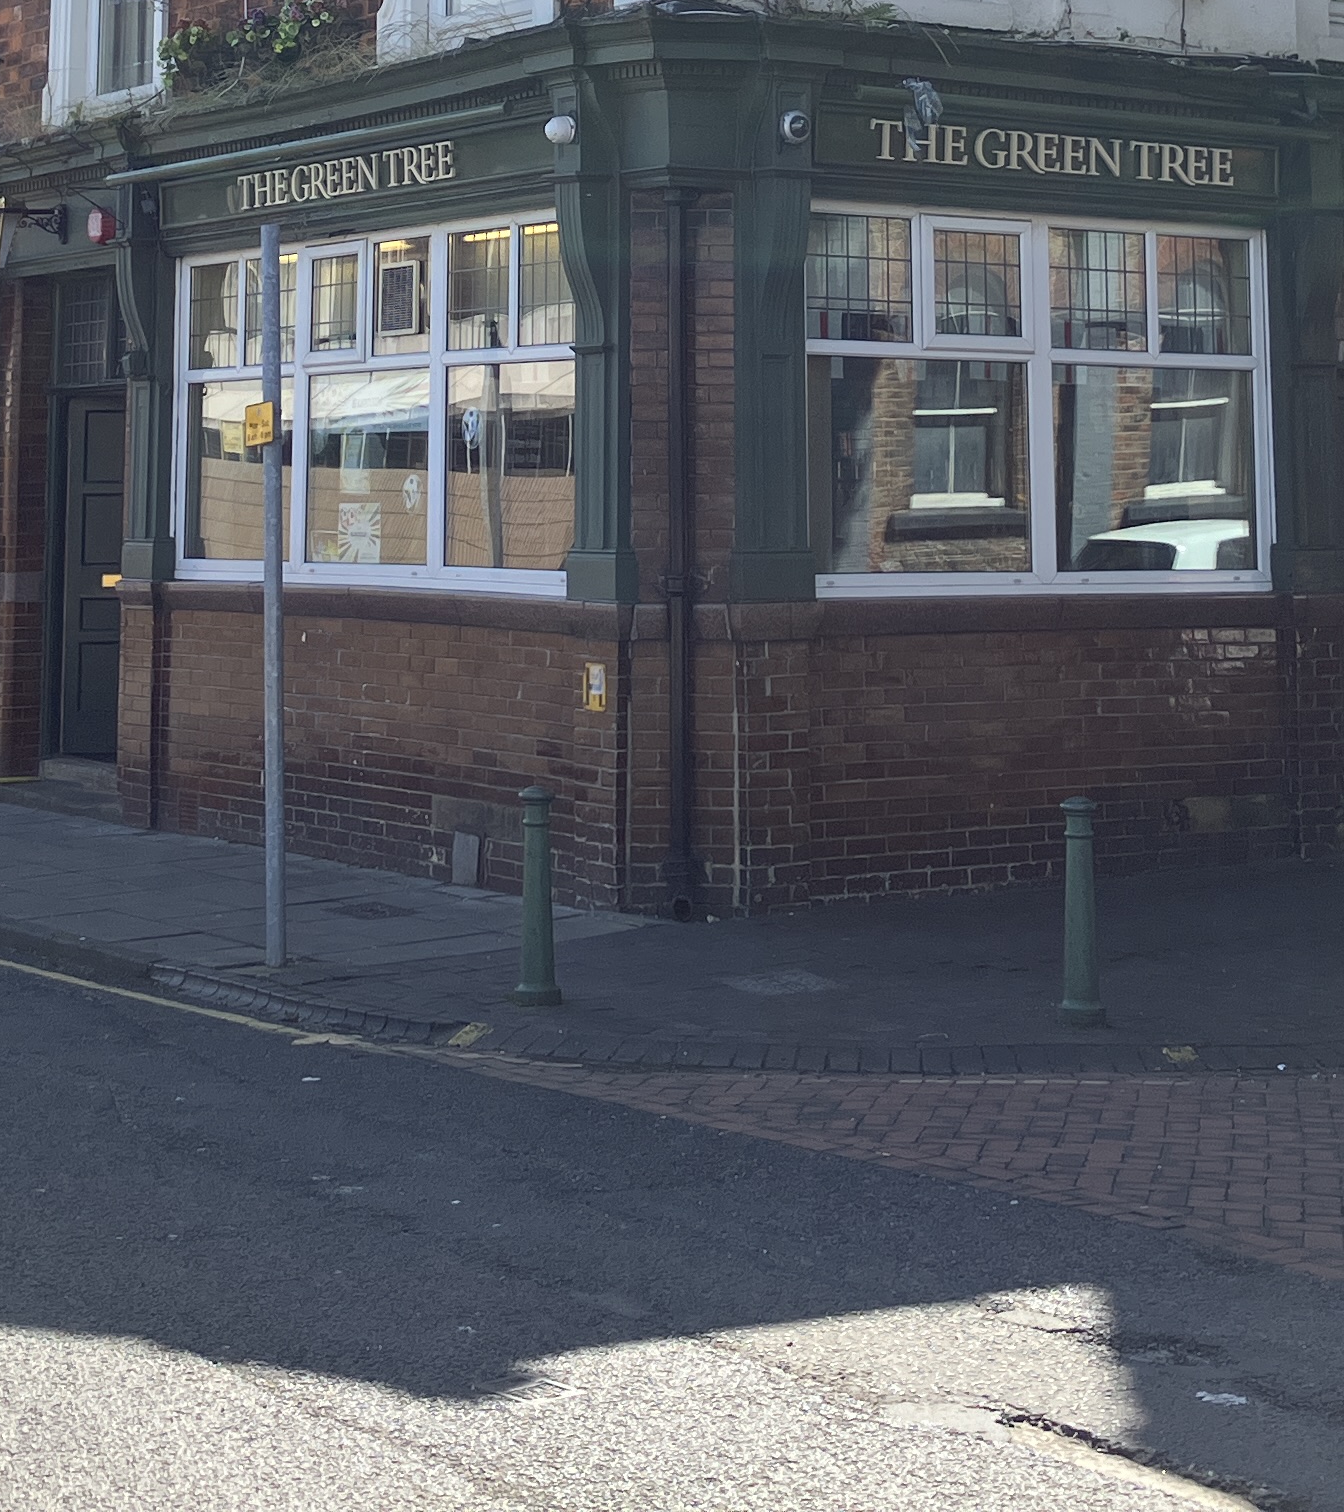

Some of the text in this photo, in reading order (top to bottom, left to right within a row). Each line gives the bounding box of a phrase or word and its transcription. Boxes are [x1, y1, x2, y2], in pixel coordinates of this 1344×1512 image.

[237, 140, 455, 210] THE GREEN TREE
[870, 117, 1235, 187] THE GREEN TREE
